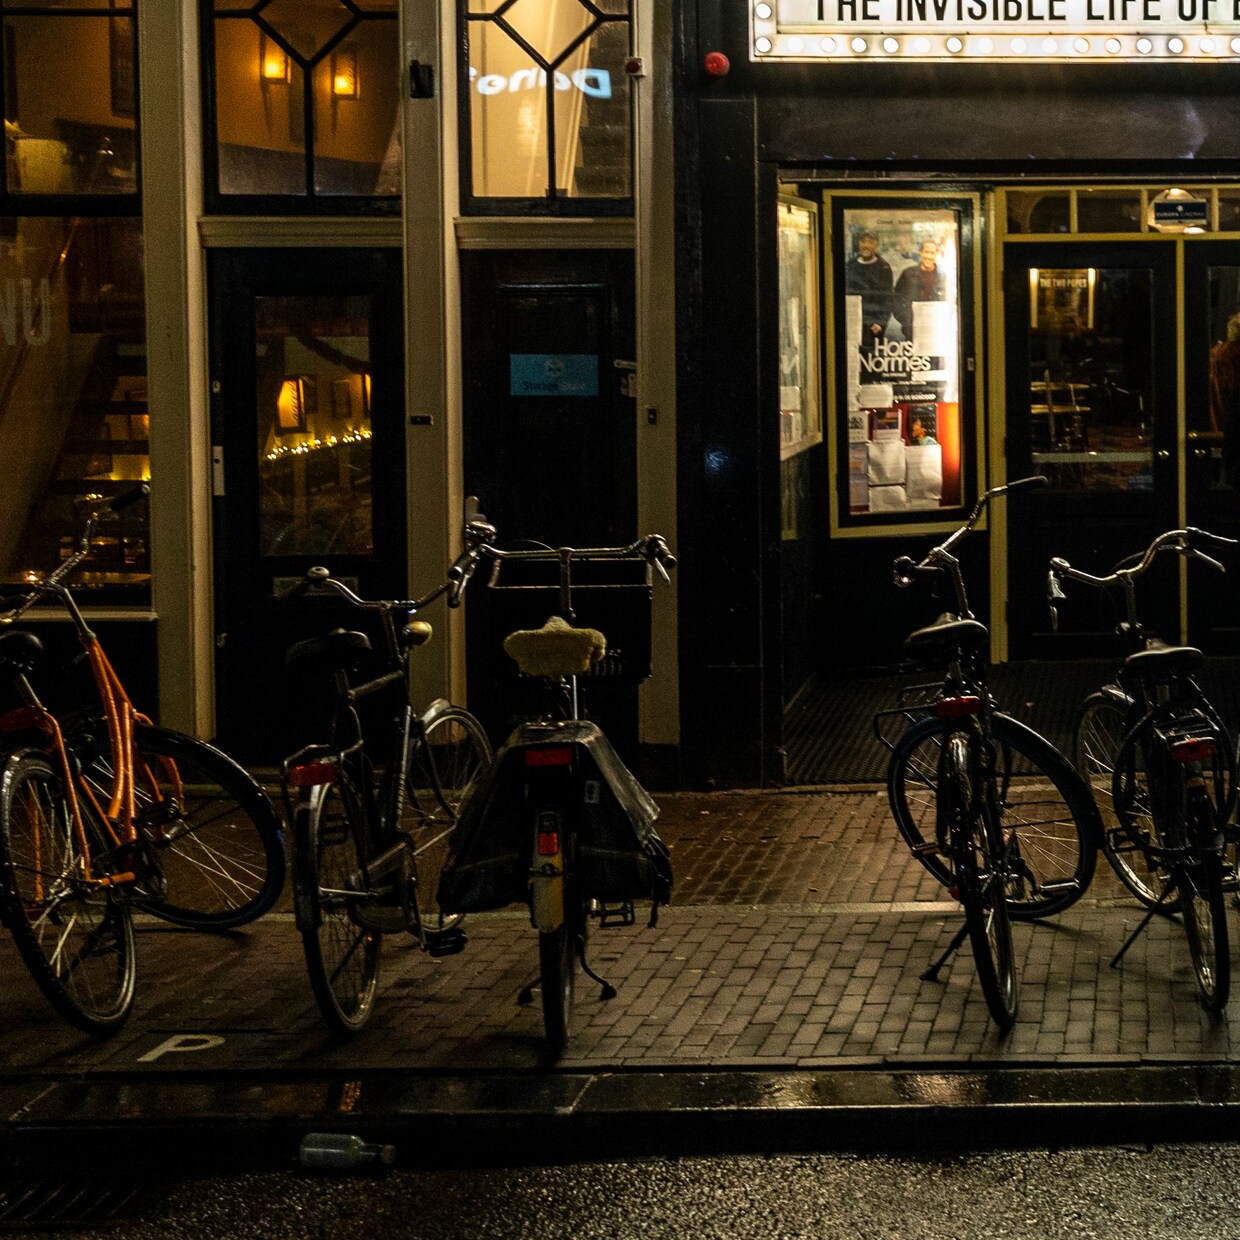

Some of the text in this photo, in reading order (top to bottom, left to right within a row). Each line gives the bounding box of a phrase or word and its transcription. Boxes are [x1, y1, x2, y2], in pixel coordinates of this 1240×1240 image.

[874, 337, 914, 357] Hors
[859, 353, 932, 373] Normes
[137, 1035, 225, 1061] P
